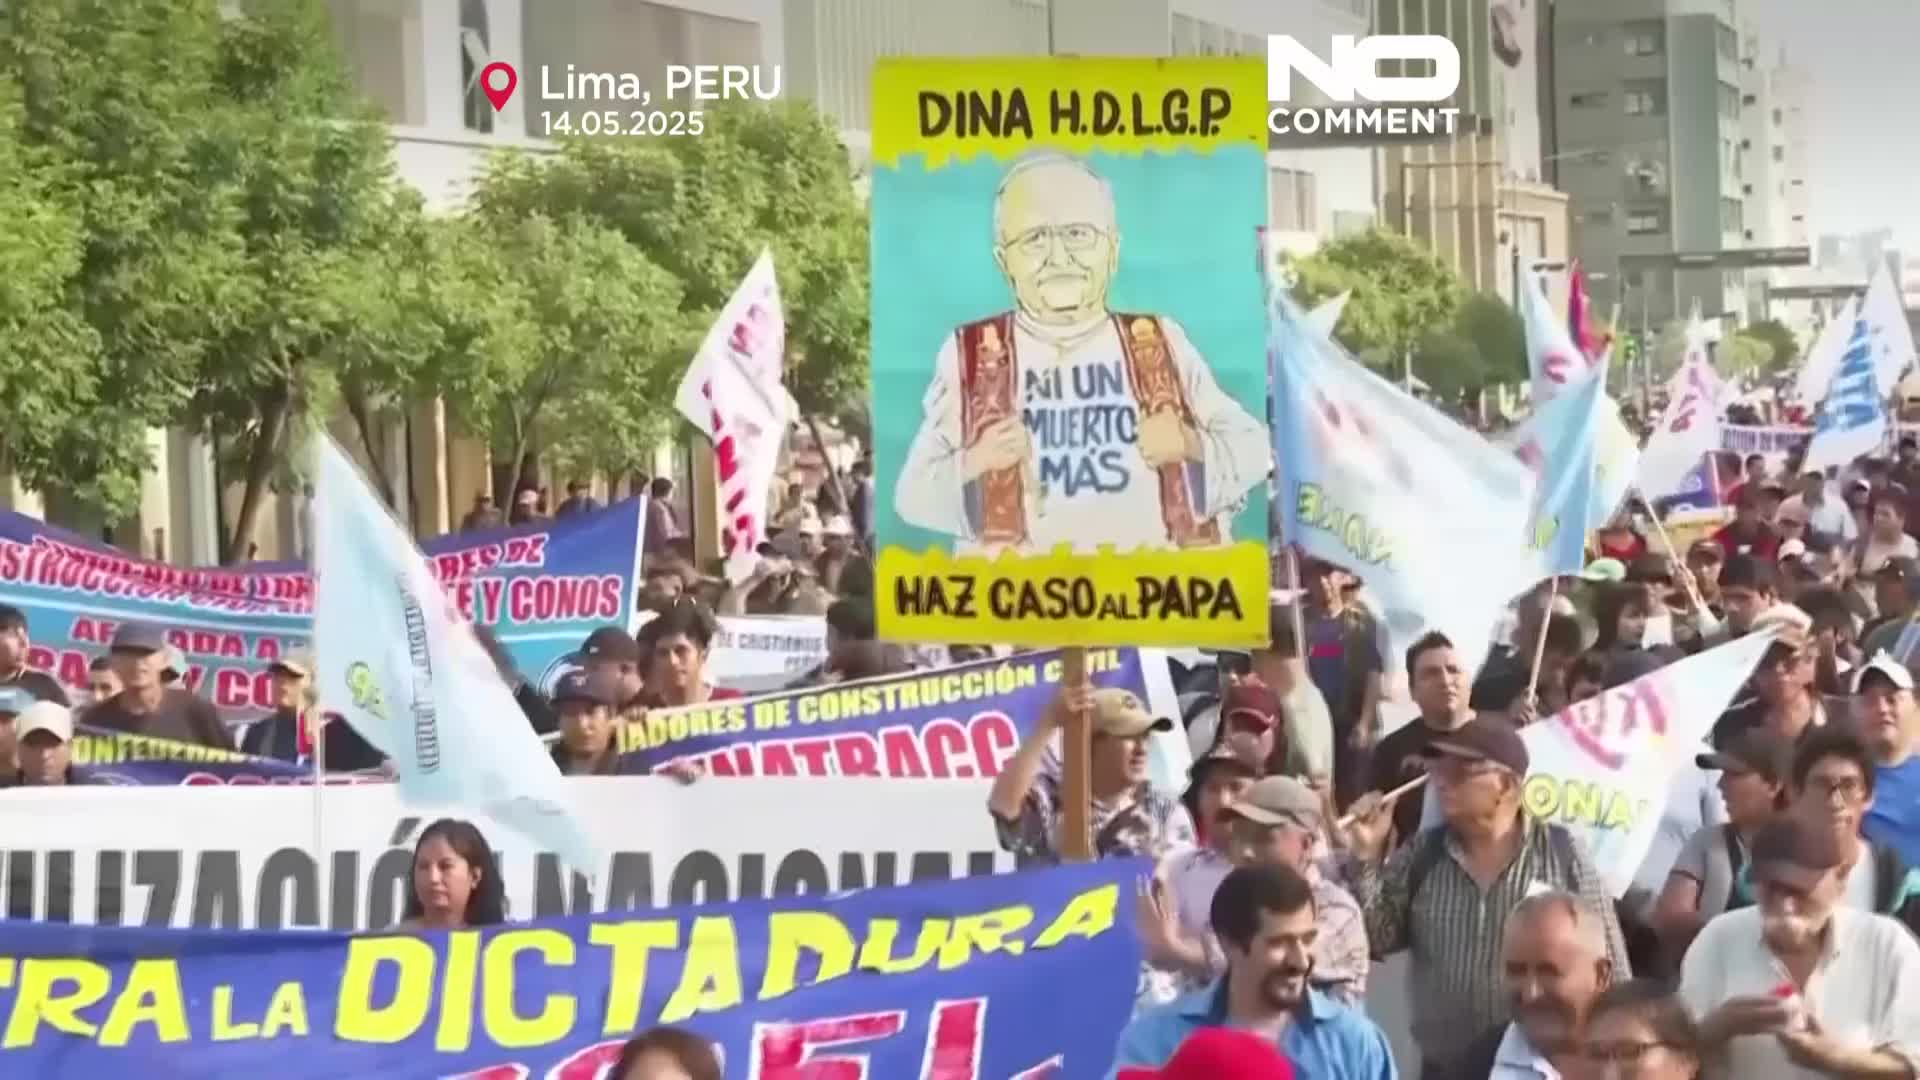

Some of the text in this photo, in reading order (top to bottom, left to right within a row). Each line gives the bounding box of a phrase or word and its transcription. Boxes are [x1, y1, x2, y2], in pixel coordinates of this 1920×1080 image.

[917, 86, 1034, 139] DINA
[1024, 360, 1124, 402] NI UN
[1023, 405, 1139, 450] MUERTO
[1039, 447, 1131, 497] MÁS
[481, 577, 505, 624] Y
[508, 574, 623, 624] CONOS
[893, 575, 1244, 621] HAZ CASO AL PAPA
[753, 699, 792, 731] DE
[797, 660, 1037, 726] CONSTRUCCIÓN
[1044, 649, 1122, 683] CVIL
[211, 980, 310, 1041] LA
[333, 882, 1120, 1052] DICTADURA
